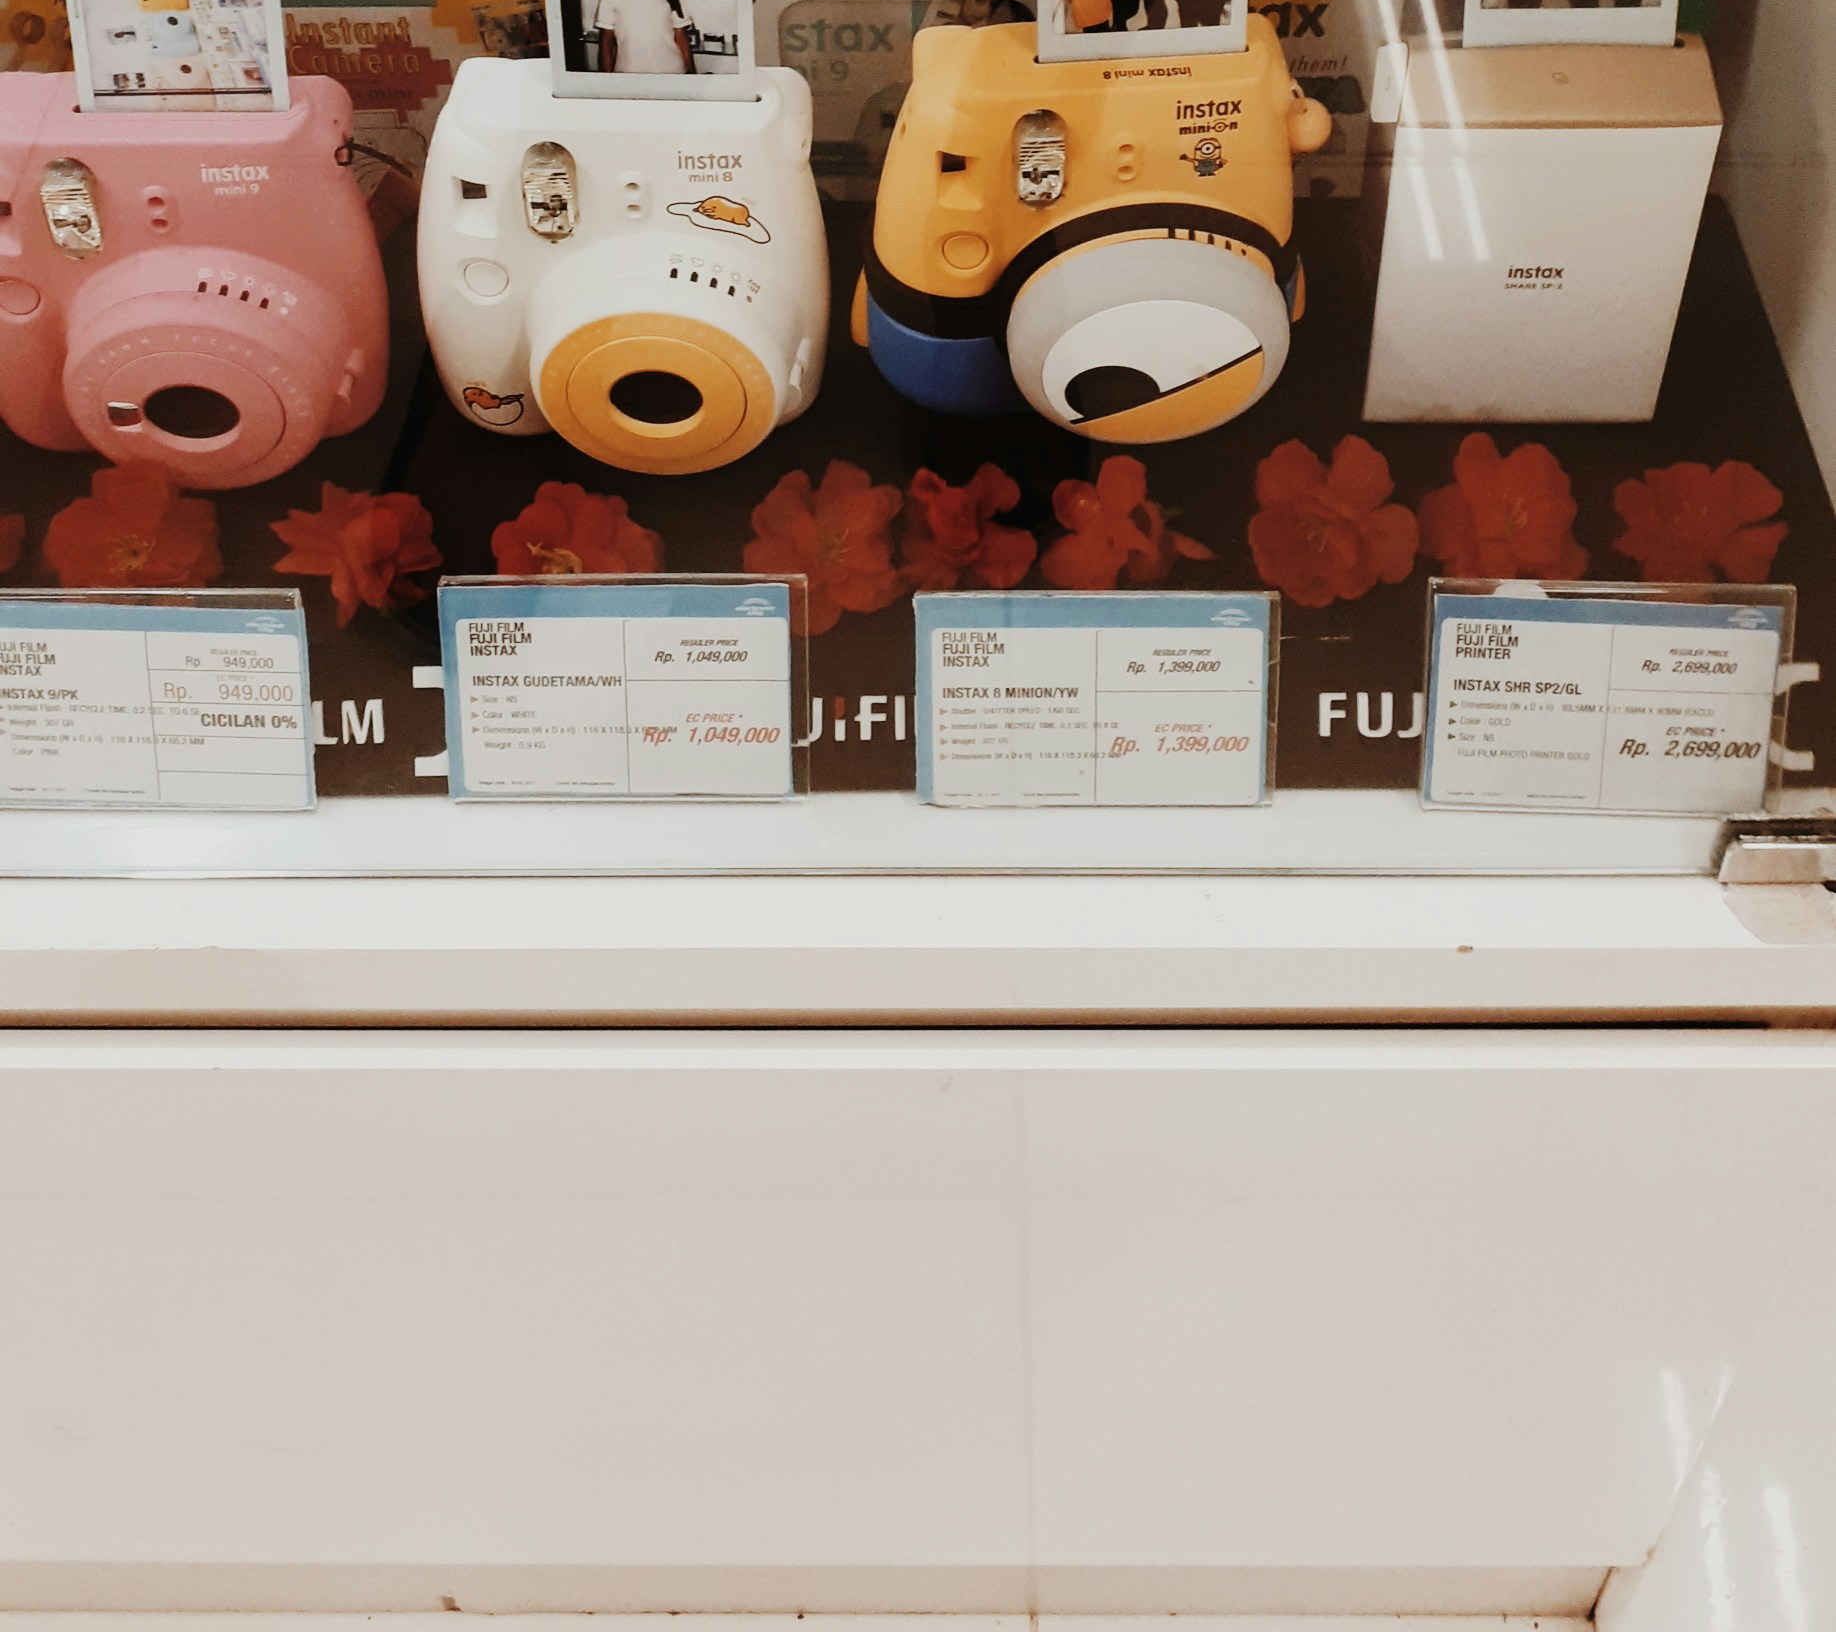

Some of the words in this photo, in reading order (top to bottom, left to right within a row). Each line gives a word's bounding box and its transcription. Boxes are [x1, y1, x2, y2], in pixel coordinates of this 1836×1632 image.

[1148, 67, 1192, 77] instax
[1176, 100, 1242, 119] instax
[677, 151, 742, 170] instax
[200, 163, 270, 184] instax
[689, 172, 719, 183] mini
[722, 171, 733, 182] 8
[213, 183, 246, 197] mini
[249, 183, 259, 195] 9
[1508, 266, 1564, 279] instax
[469, 622, 494, 633] FUJI
[497, 622, 524, 633] FILM
[1456, 623, 1481, 635] FUJI
[1484, 623, 1513, 636] FILM
[469, 633, 497, 644] FUJI
[501, 633, 532, 644] FILM
[942, 632, 966, 643] FUJI
[970, 632, 997, 643] FILM
[1456, 634, 1484, 647] FUJI
[1487, 635, 1520, 648] FILM
[470, 645, 518, 657] INSTAX
[942, 643, 970, 655] FUJI
[974, 643, 1005, 655] FILM
[1455, 647, 1511, 660] PRINTER
[654, 650, 675, 664] Rp.
[686, 649, 748, 663] 1,049,000
[942, 655, 990, 668] INSTAX
[1126, 661, 1147, 675] Rp.
[1158, 660, 1221, 674] 1,399,000
[1641, 659, 1662, 674] Rp.
[1672, 660, 1738, 676] 2,699,000
[472, 676, 519, 687] INSTAX
[523, 675, 622, 688] GUDETAMA/WH
[1454, 679, 1500, 692] INSTAX
[1505, 681, 1531, 693] SHR
[1535, 682, 1582, 695] SP2/GL
[163, 682, 193, 703] Rp.
[218, 684, 293, 704] 949,000
[942, 687, 990, 699] INSTAX
[993, 688, 1001, 699] 8
[1005, 687, 1079, 699] MINION/YW
[200, 714, 266, 728] CICILAN
[272, 715, 297, 730] 0%
[686, 713, 700, 723] EC
[702, 713, 735, 723] PRICE
[1154, 723, 1168, 733] EC
[1170, 723, 1204, 733] PRICE
[642, 727, 673, 746] Rp.
[688, 726, 781, 745] 1,049,000
[1110, 737, 1141, 756] Rp.
[1156, 736, 1250, 754] 1,399,000
[1619, 739, 1650, 758] Rp.
[1664, 740, 1761, 761] 2,699,000
